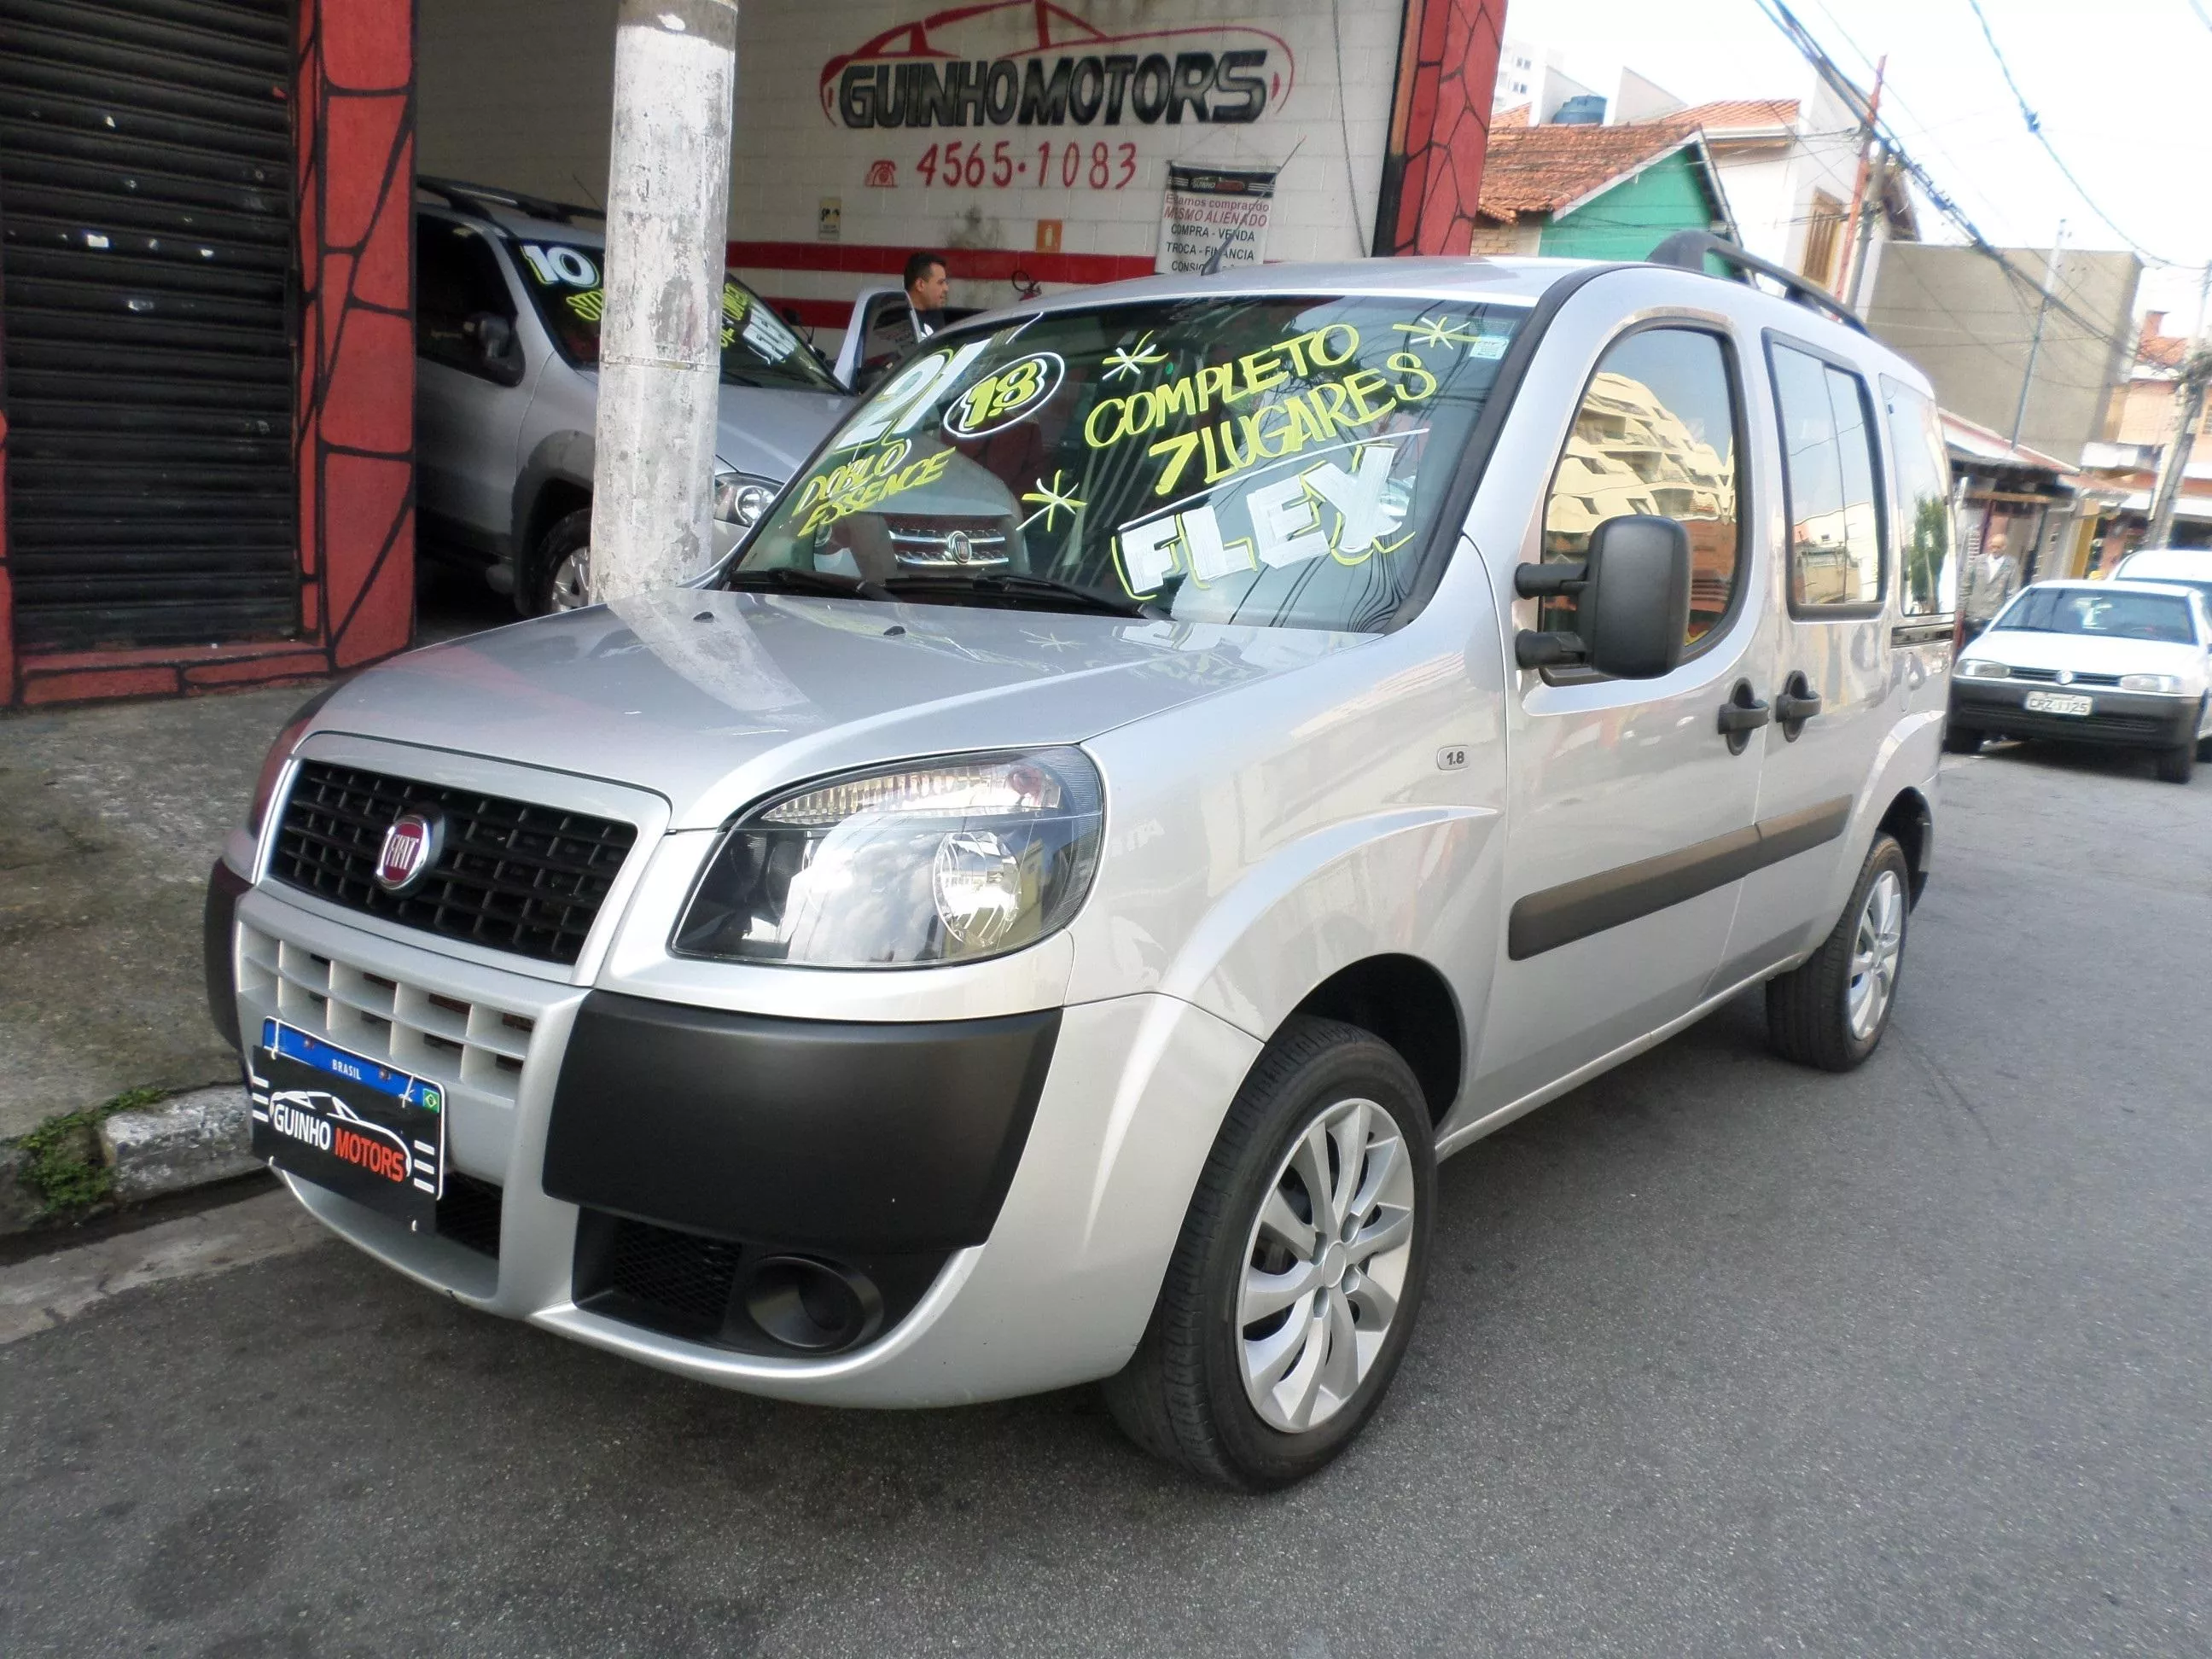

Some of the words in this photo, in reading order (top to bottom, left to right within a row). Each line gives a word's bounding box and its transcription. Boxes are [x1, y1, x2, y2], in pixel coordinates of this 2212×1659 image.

[839, 59, 1018, 129] GUINHO
[1018, 49, 1268, 125] MOTORS
[1171, 223, 1209, 238] COMPRA
[1205, 209, 1268, 227] ALIENADO
[519, 245, 600, 287] 10
[1167, 242, 1196, 255] TROCA
[1085, 323, 1360, 449] COMPLETO
[1202, 353, 1437, 484] LUGARES
[1115, 444, 1408, 598] FLEX
[1447, 750, 1465, 765] 1.8
[331, 1058, 362, 1080] BRASIL
[273, 1103, 331, 1151] GUINHO
[334, 1127, 405, 1183] MOTORS
